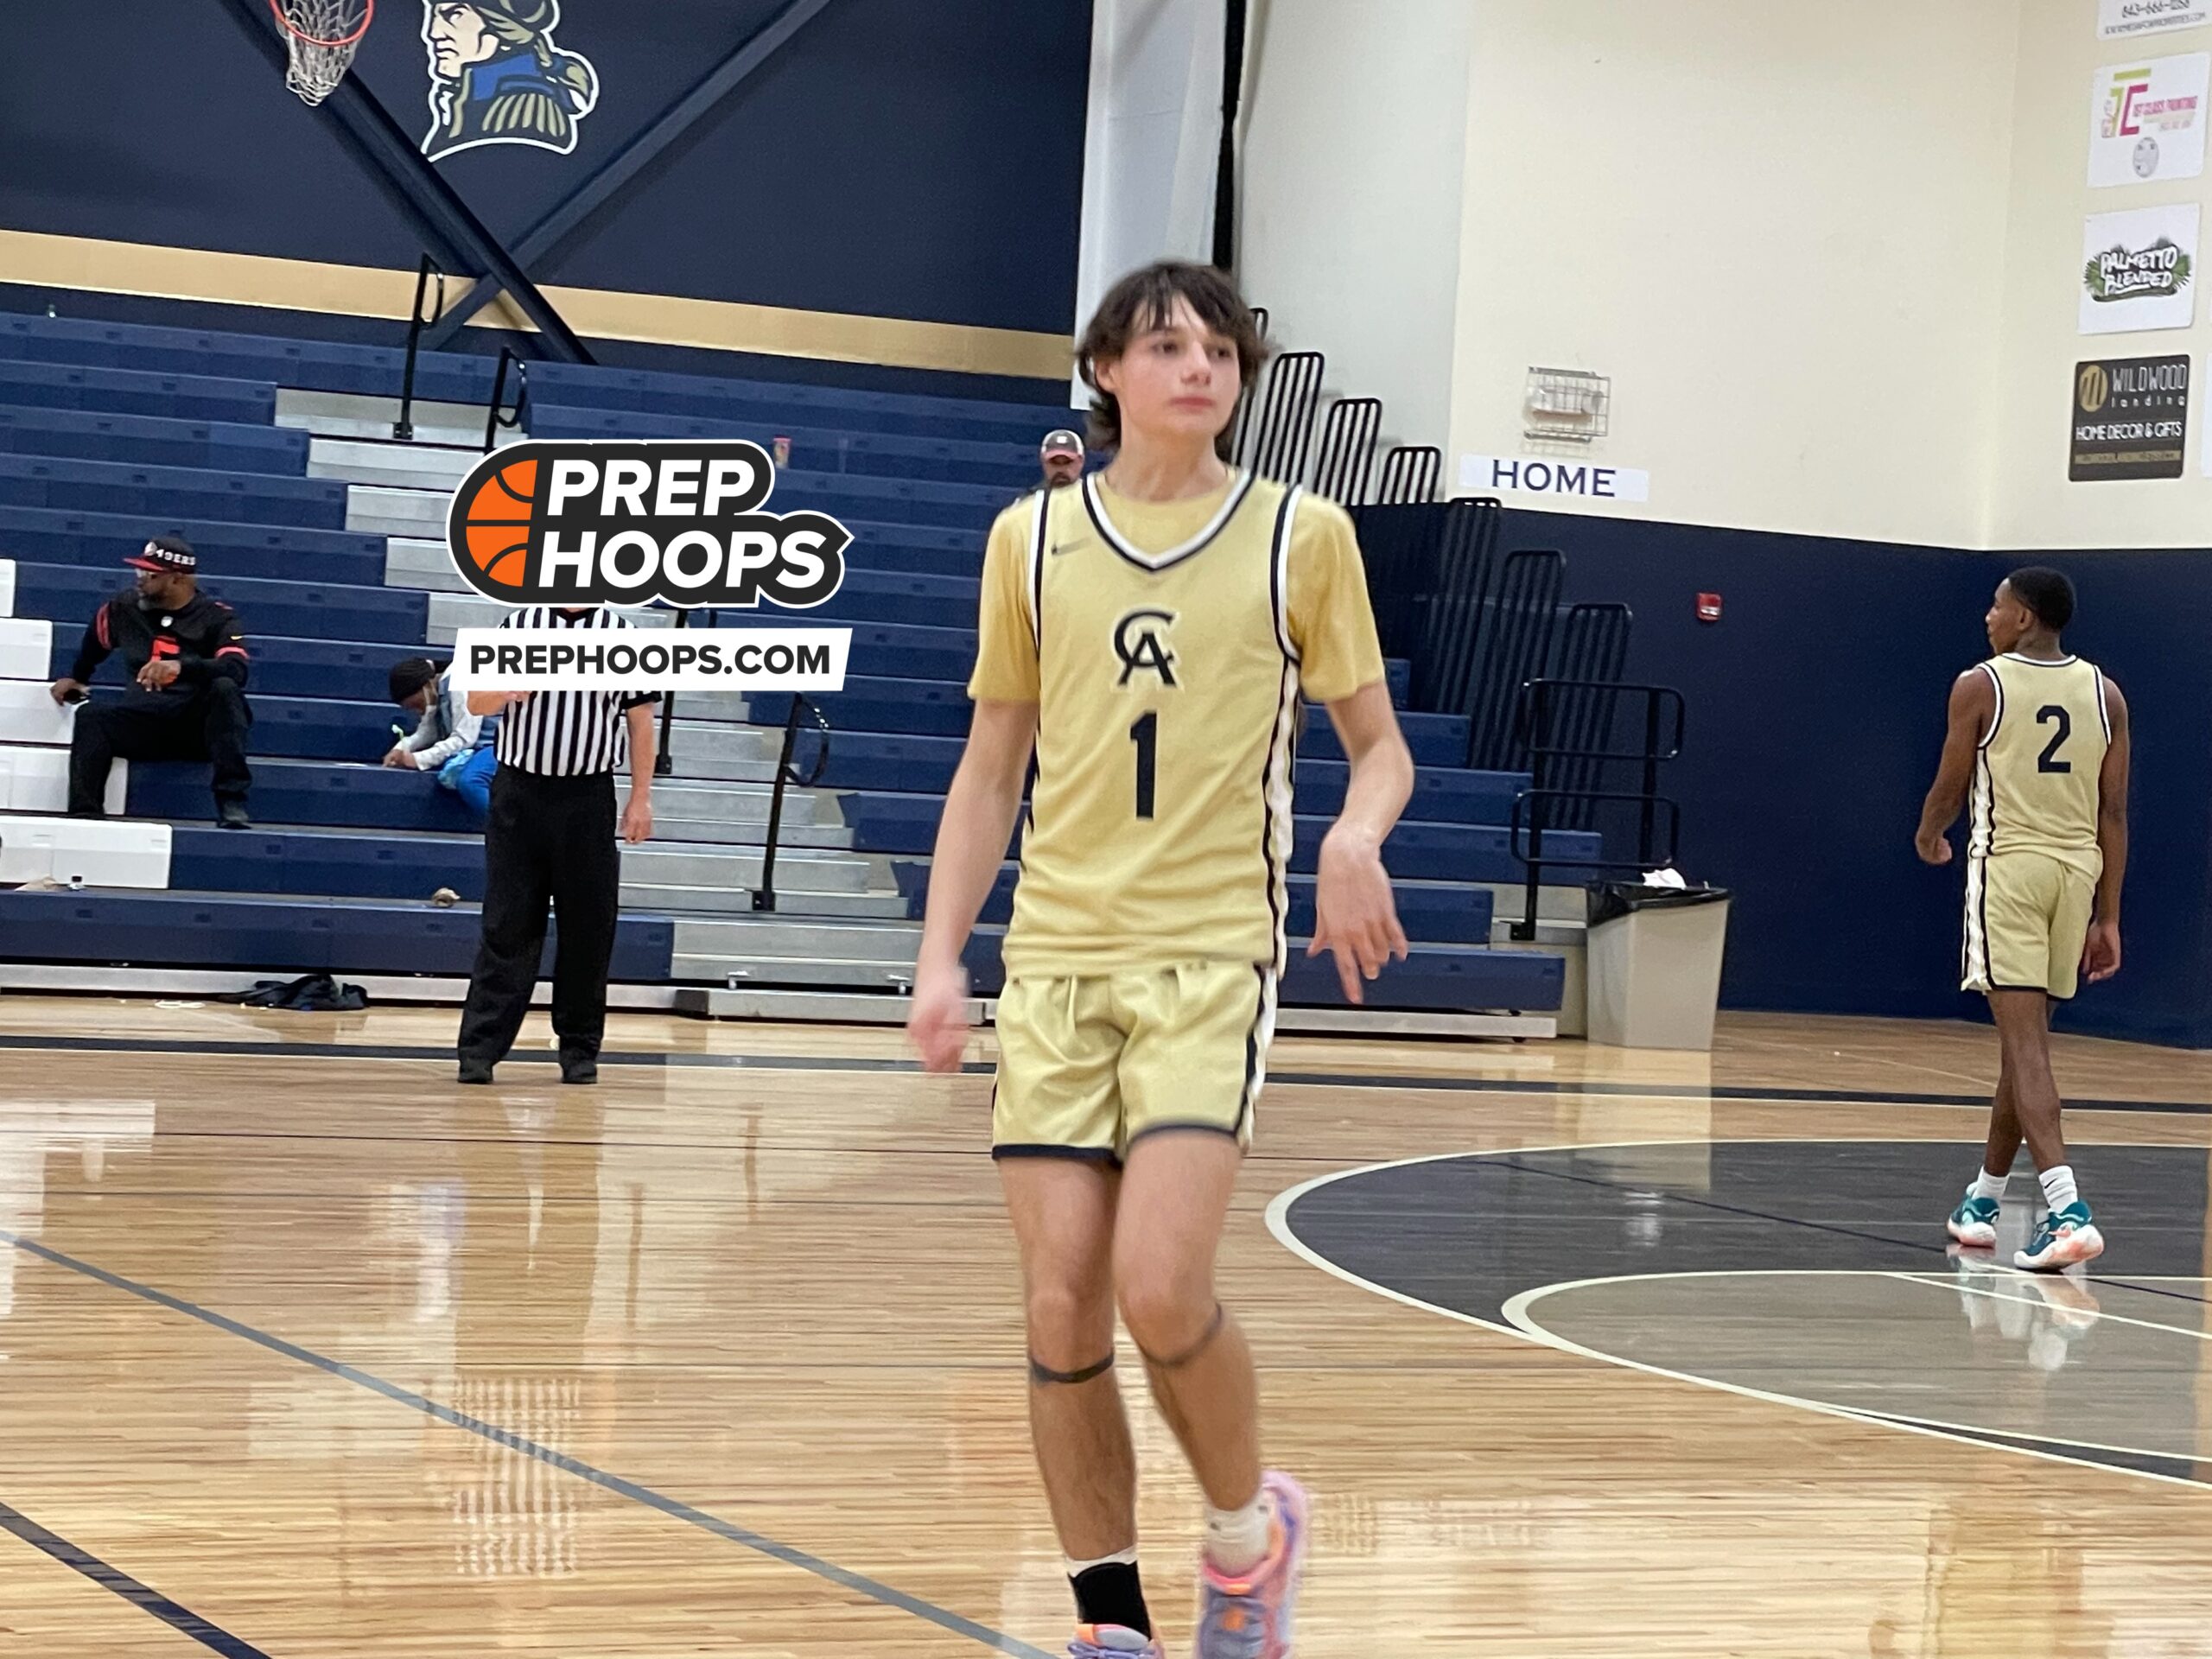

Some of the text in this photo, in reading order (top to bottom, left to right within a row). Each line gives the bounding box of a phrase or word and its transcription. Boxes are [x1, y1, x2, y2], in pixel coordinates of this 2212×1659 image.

[2100, 245, 2178, 277] PALMETTO
[2113, 364, 2187, 393] WILDWOOD
[2111, 395, 2186, 408] landing
[2075, 421, 2183, 441] HOME DECOR & GIFTS
[1492, 459, 1616, 498] HOME
[156, 549, 197, 567] 49ERS
[2036, 704, 2072, 774] 2
[1129, 710, 1158, 821] 1
